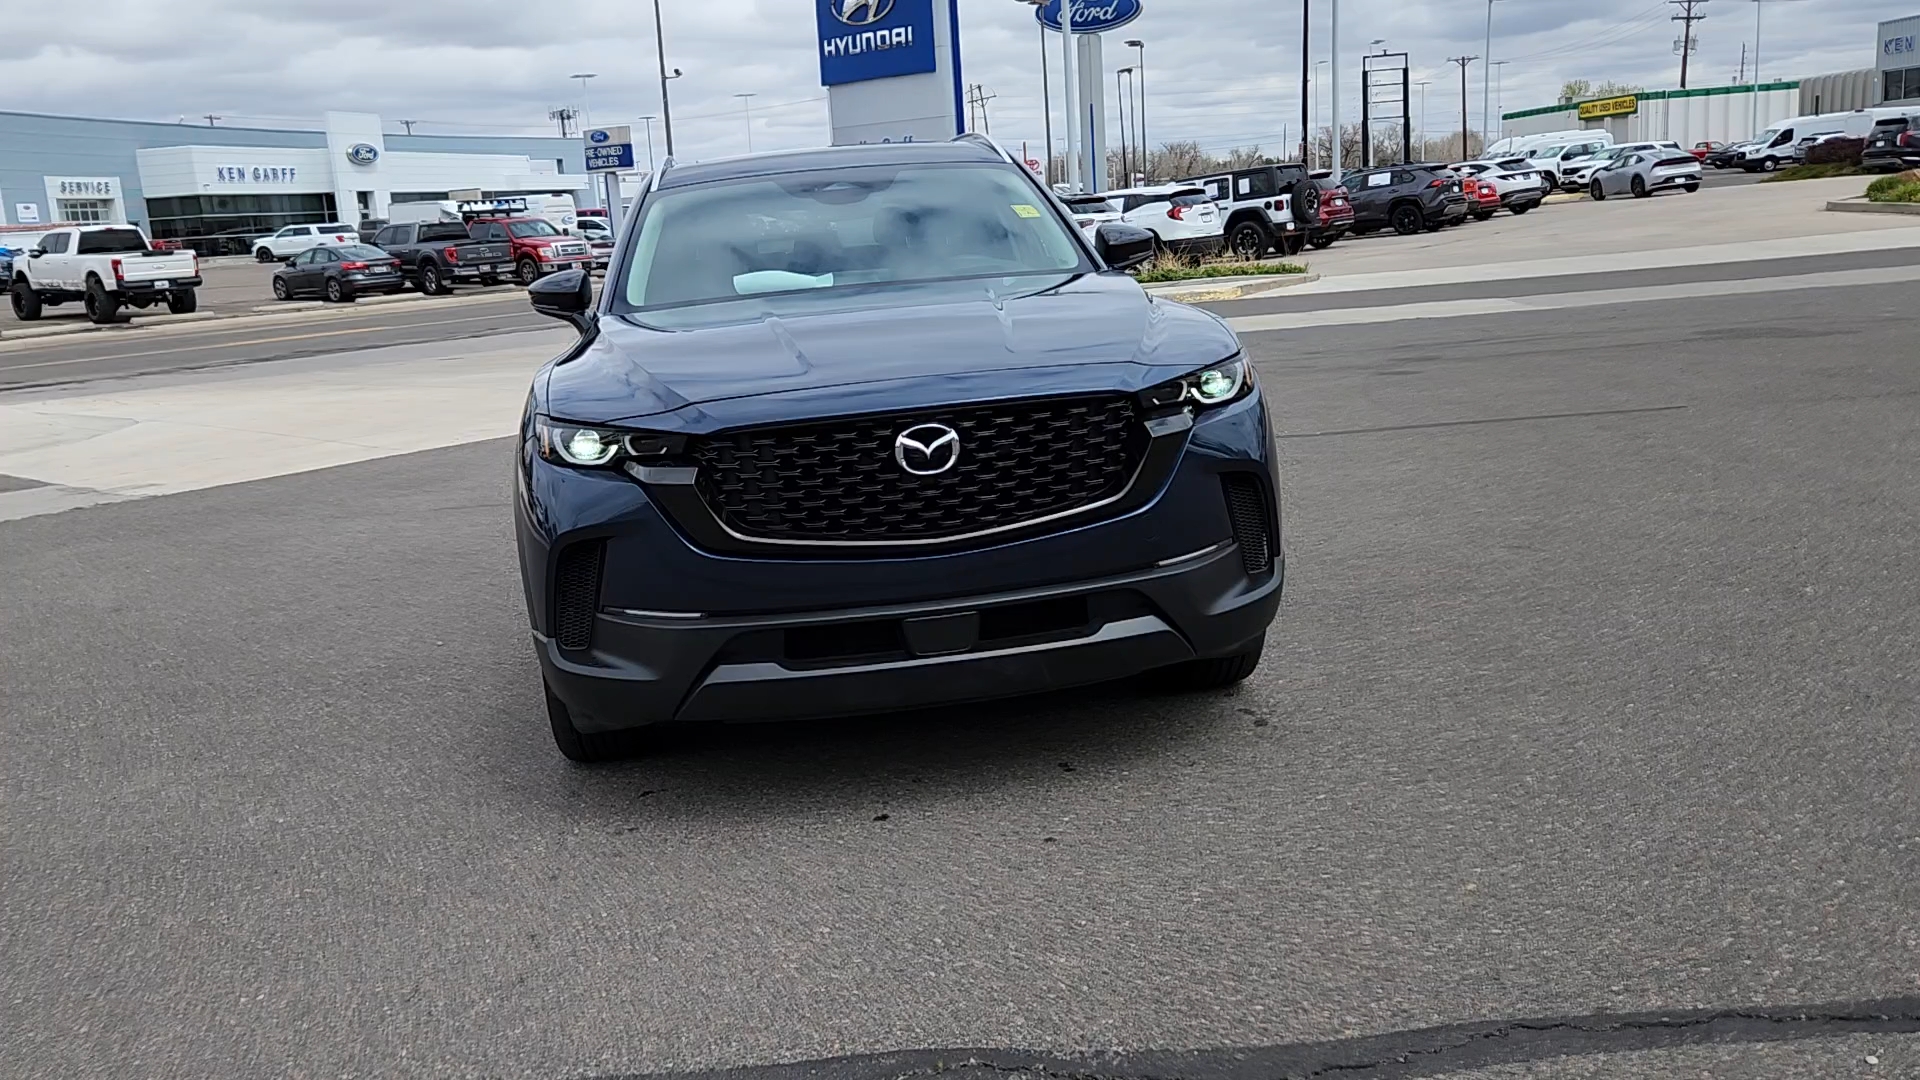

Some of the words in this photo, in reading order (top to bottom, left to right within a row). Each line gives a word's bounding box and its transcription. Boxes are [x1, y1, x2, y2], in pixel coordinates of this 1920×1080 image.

[823, 26, 913, 57] HYUNDAI
[1884, 36, 1916, 54] KEN
[1580, 104, 1599, 115] QUALITY
[1612, 99, 1635, 111] VEHICLES
[588, 157, 619, 168] VEHICLES
[217, 166, 246, 182] KEN
[252, 166, 296, 183] GARFF
[60, 181, 111, 194] SERVICE
